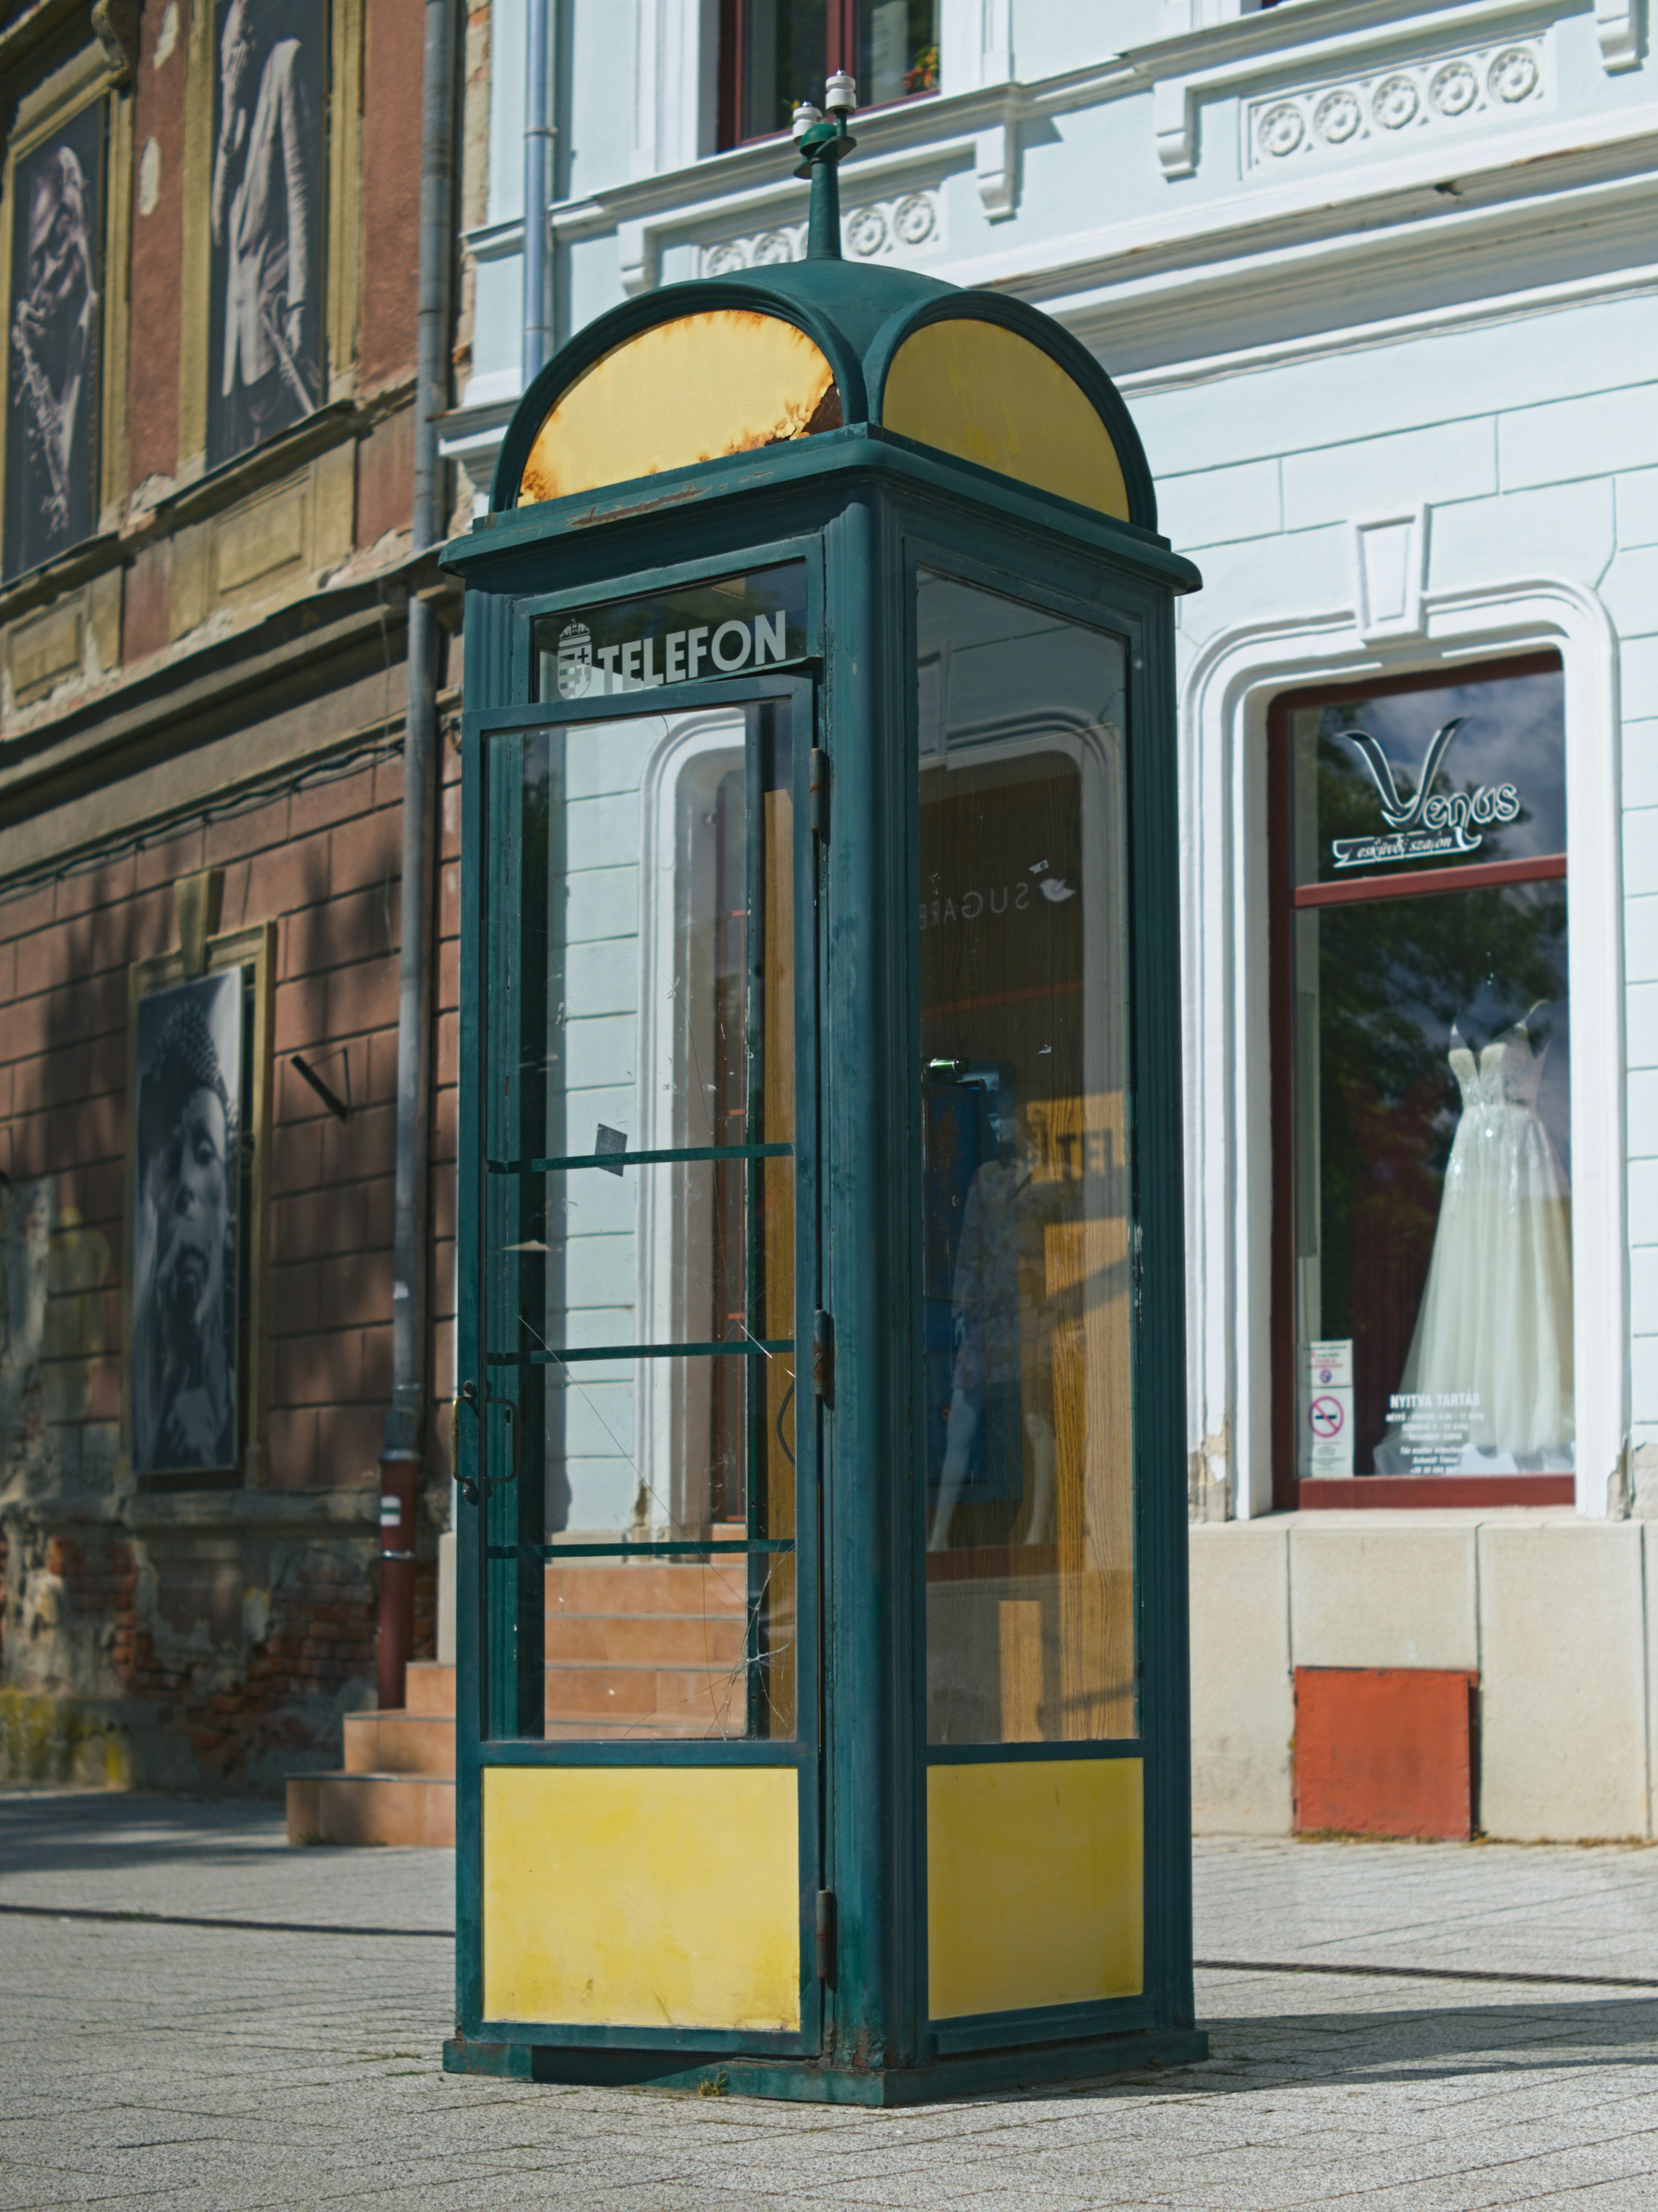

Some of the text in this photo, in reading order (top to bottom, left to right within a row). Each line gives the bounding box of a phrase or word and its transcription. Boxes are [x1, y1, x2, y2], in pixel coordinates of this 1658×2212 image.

[597, 610, 786, 695] TELEFON
[1336, 715, 1520, 844] Venus
[1390, 1390, 1480, 1408] NYITVA TARTÁS
